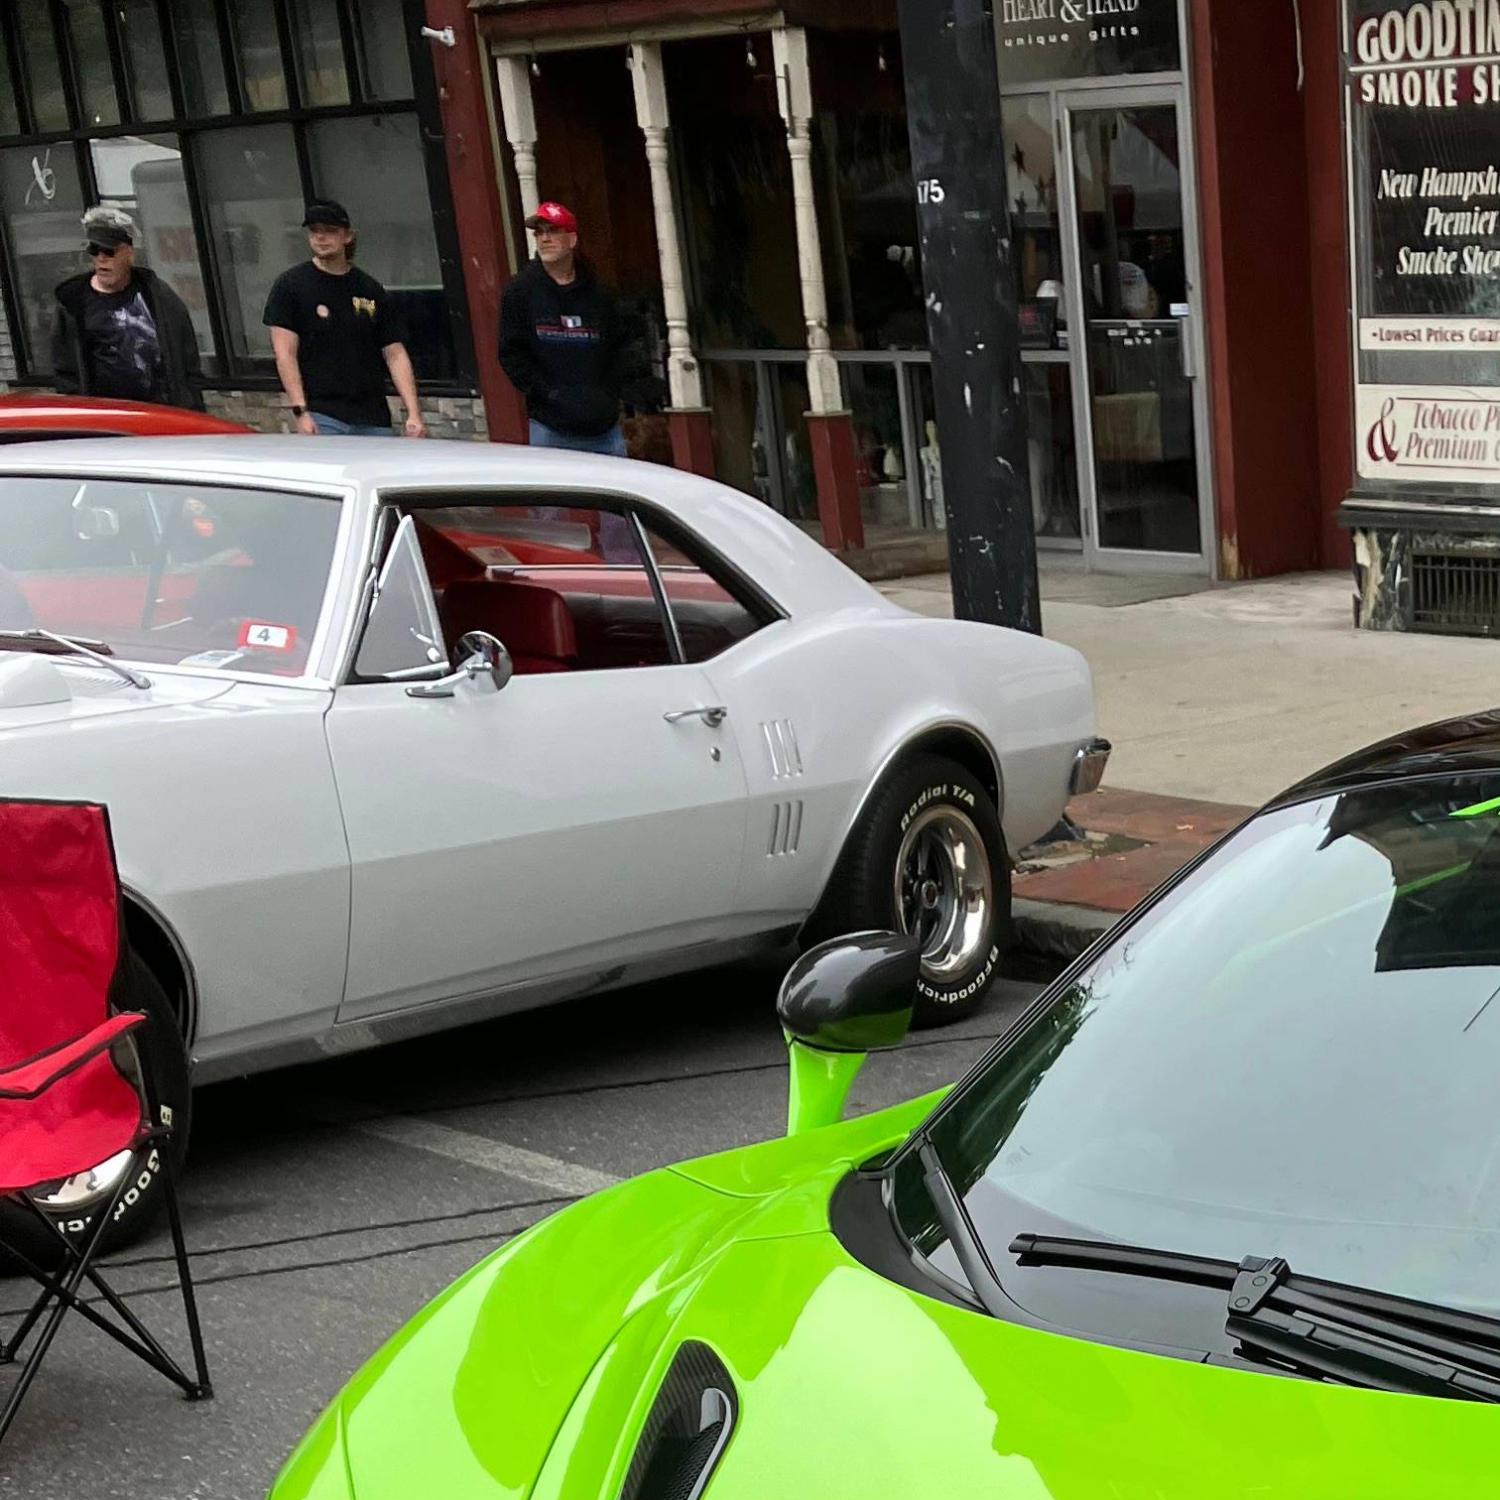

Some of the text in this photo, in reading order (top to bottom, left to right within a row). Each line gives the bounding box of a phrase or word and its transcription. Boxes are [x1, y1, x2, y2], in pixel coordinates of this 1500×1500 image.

[1004, 26, 1139, 47] unique gifts
[1361, 68, 1457, 107] SMOKE
[1377, 168, 1418, 200] New
[1423, 206, 1499, 236] Premier
[1396, 246, 1458, 275] Smoke
[1426, 326, 1464, 342] Prices
[1367, 397, 1398, 462] &
[1413, 402, 1480, 431] Tobacco
[1405, 431, 1487, 461] Premium
[257, 627, 271, 642] 4
[901, 784, 948, 832] Radial
